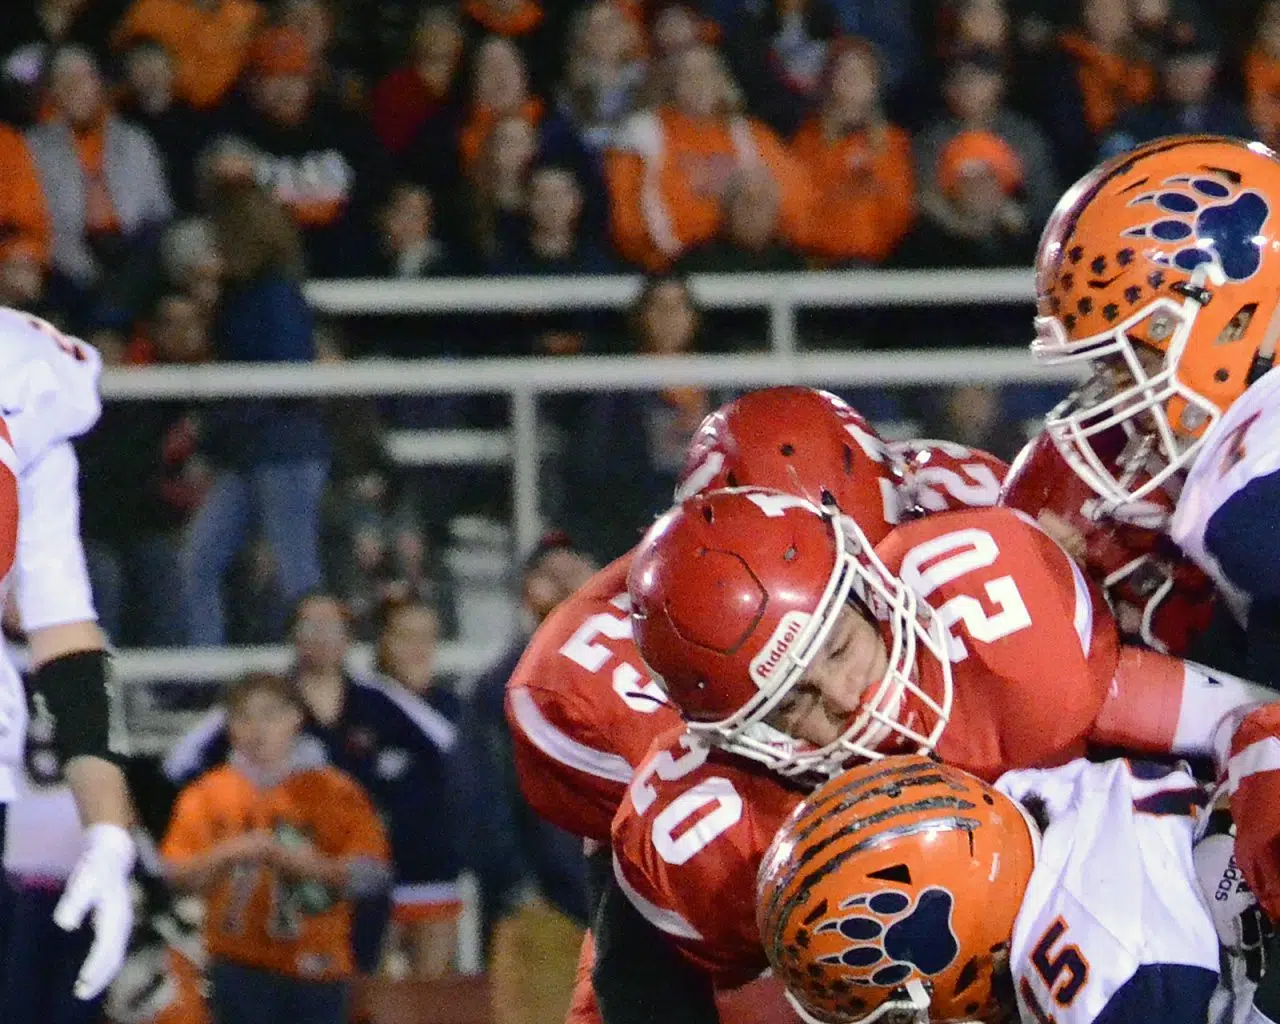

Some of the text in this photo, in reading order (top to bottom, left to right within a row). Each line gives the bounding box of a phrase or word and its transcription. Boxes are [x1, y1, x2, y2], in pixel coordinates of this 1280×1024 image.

[755, 620, 801, 678] Riddell
[902, 528, 1031, 663] 20
[631, 733, 743, 866] 20
